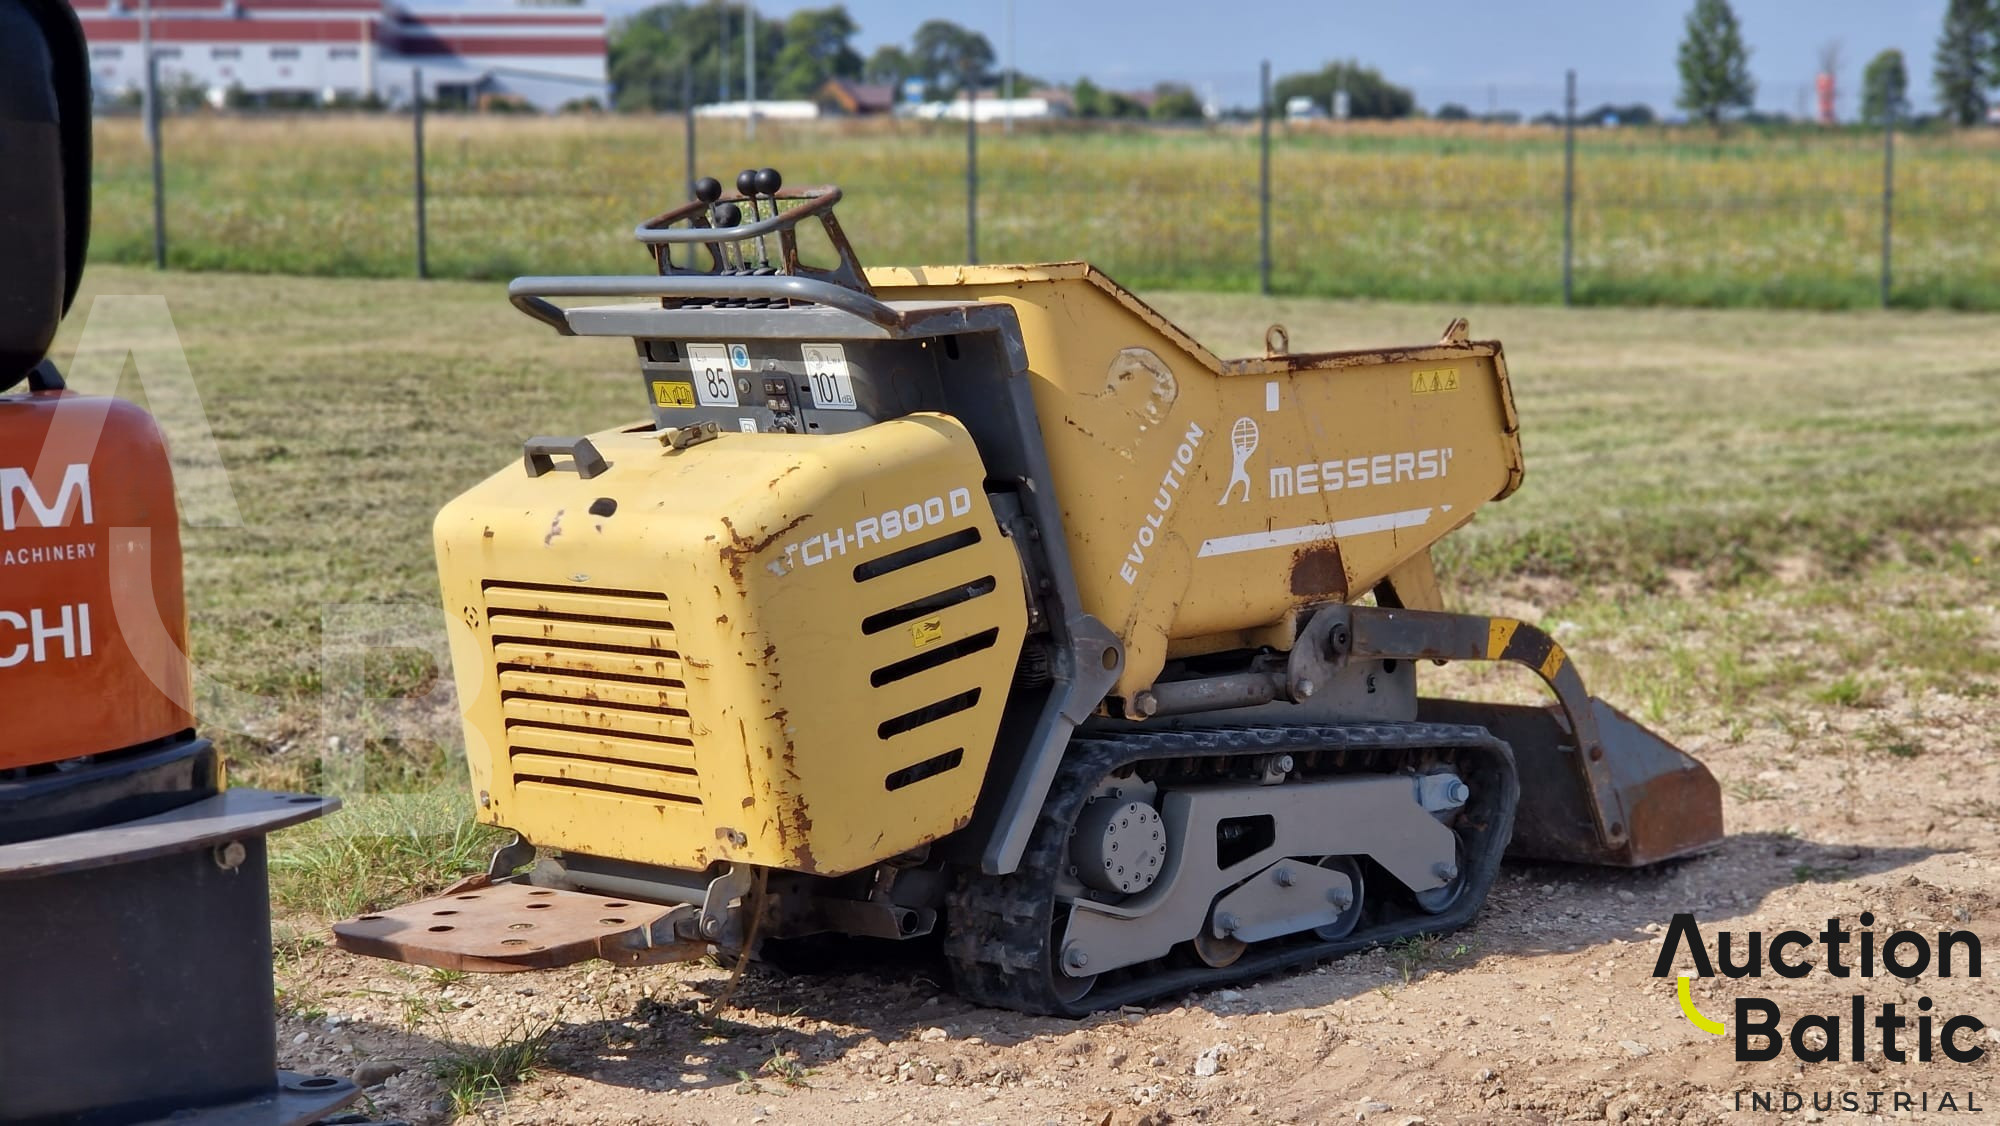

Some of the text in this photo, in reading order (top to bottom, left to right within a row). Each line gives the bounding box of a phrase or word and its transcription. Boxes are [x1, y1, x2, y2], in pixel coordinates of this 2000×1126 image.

[706, 367, 729, 398] 85
[813, 372, 841, 403] 101
[949, 487, 972, 518] D
[1119, 421, 1206, 586] EVOLUTION
[0, 543, 97, 567] ACHINERY
